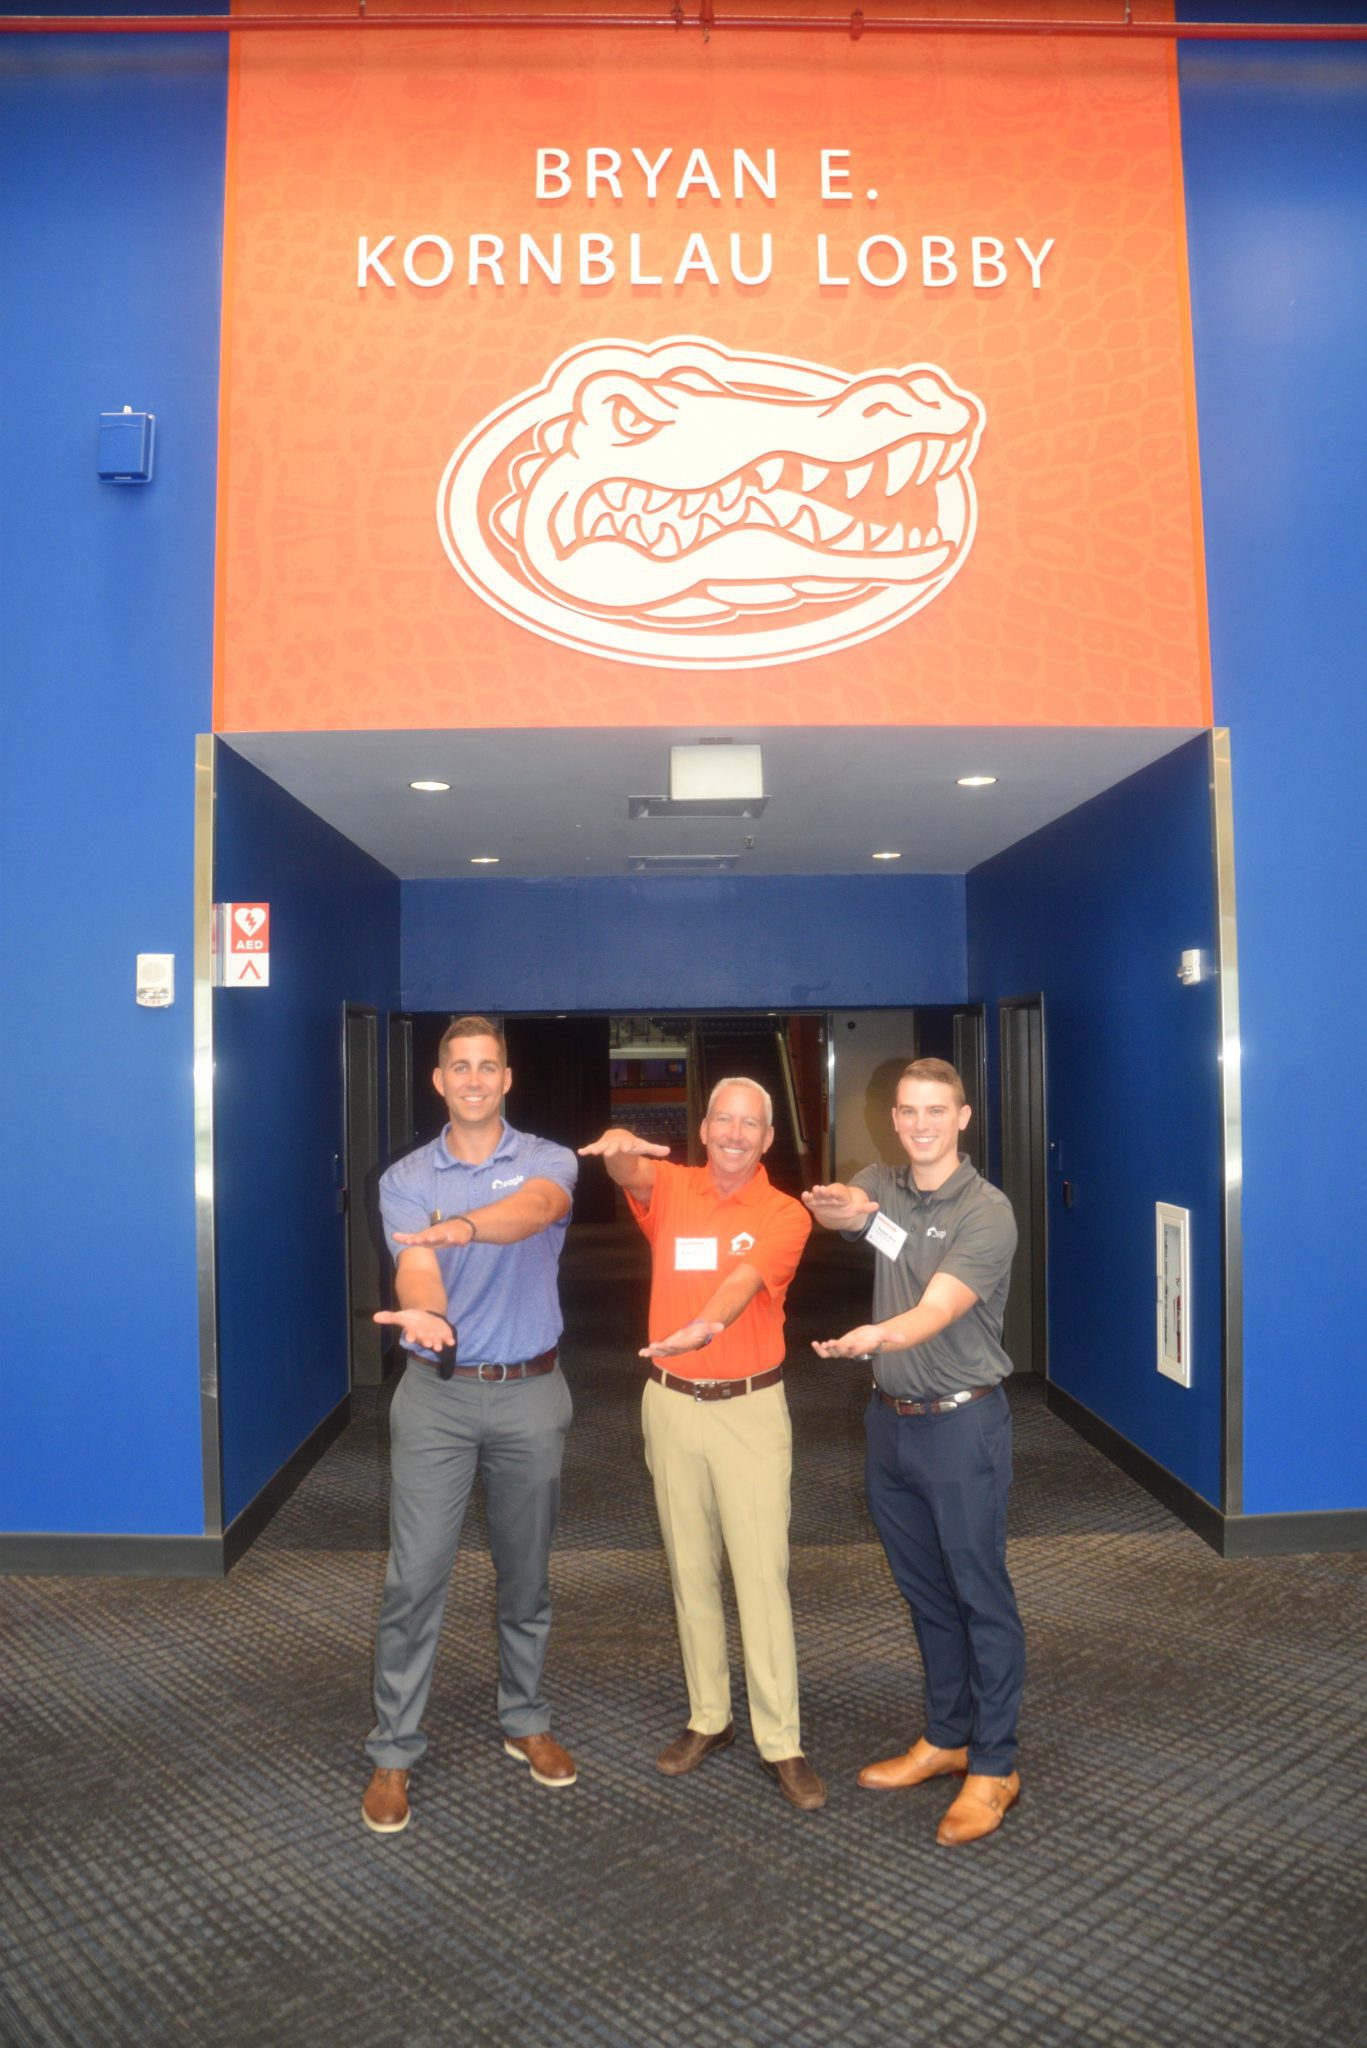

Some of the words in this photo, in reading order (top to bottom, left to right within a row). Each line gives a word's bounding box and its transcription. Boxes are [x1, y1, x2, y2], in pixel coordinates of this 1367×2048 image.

[535, 147, 778, 200] BRYAN
[821, 149, 879, 200] E.
[357, 232, 774, 289] KORNBLAU
[817, 233, 1056, 290] LOBBY
[235, 939, 264, 950] AED
